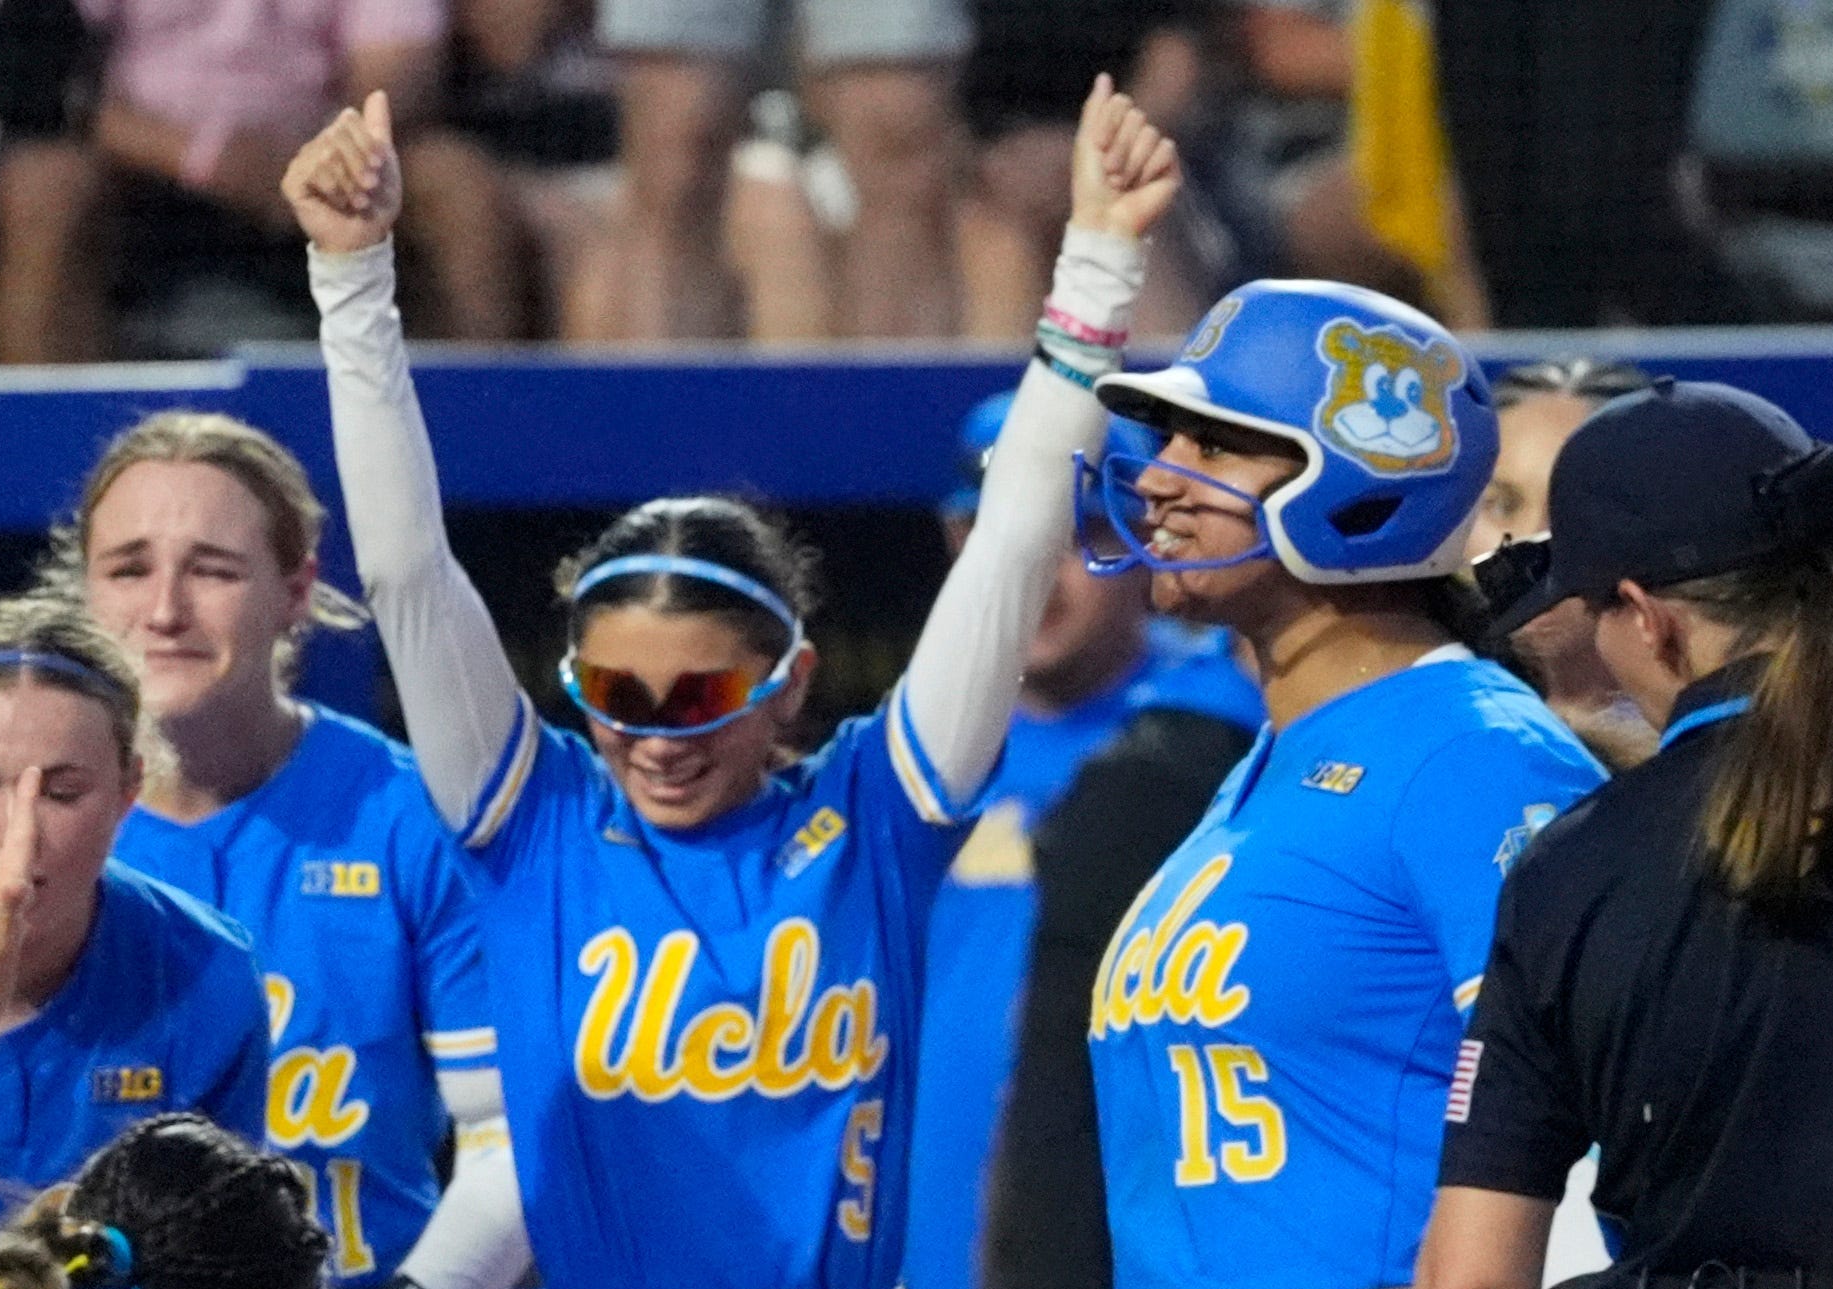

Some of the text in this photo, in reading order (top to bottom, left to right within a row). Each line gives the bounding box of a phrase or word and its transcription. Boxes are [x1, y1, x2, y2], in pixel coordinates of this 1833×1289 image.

[575, 915, 889, 1103] Ucla
[837, 1097, 885, 1243] 5
[1167, 1043, 1288, 1188] 15
